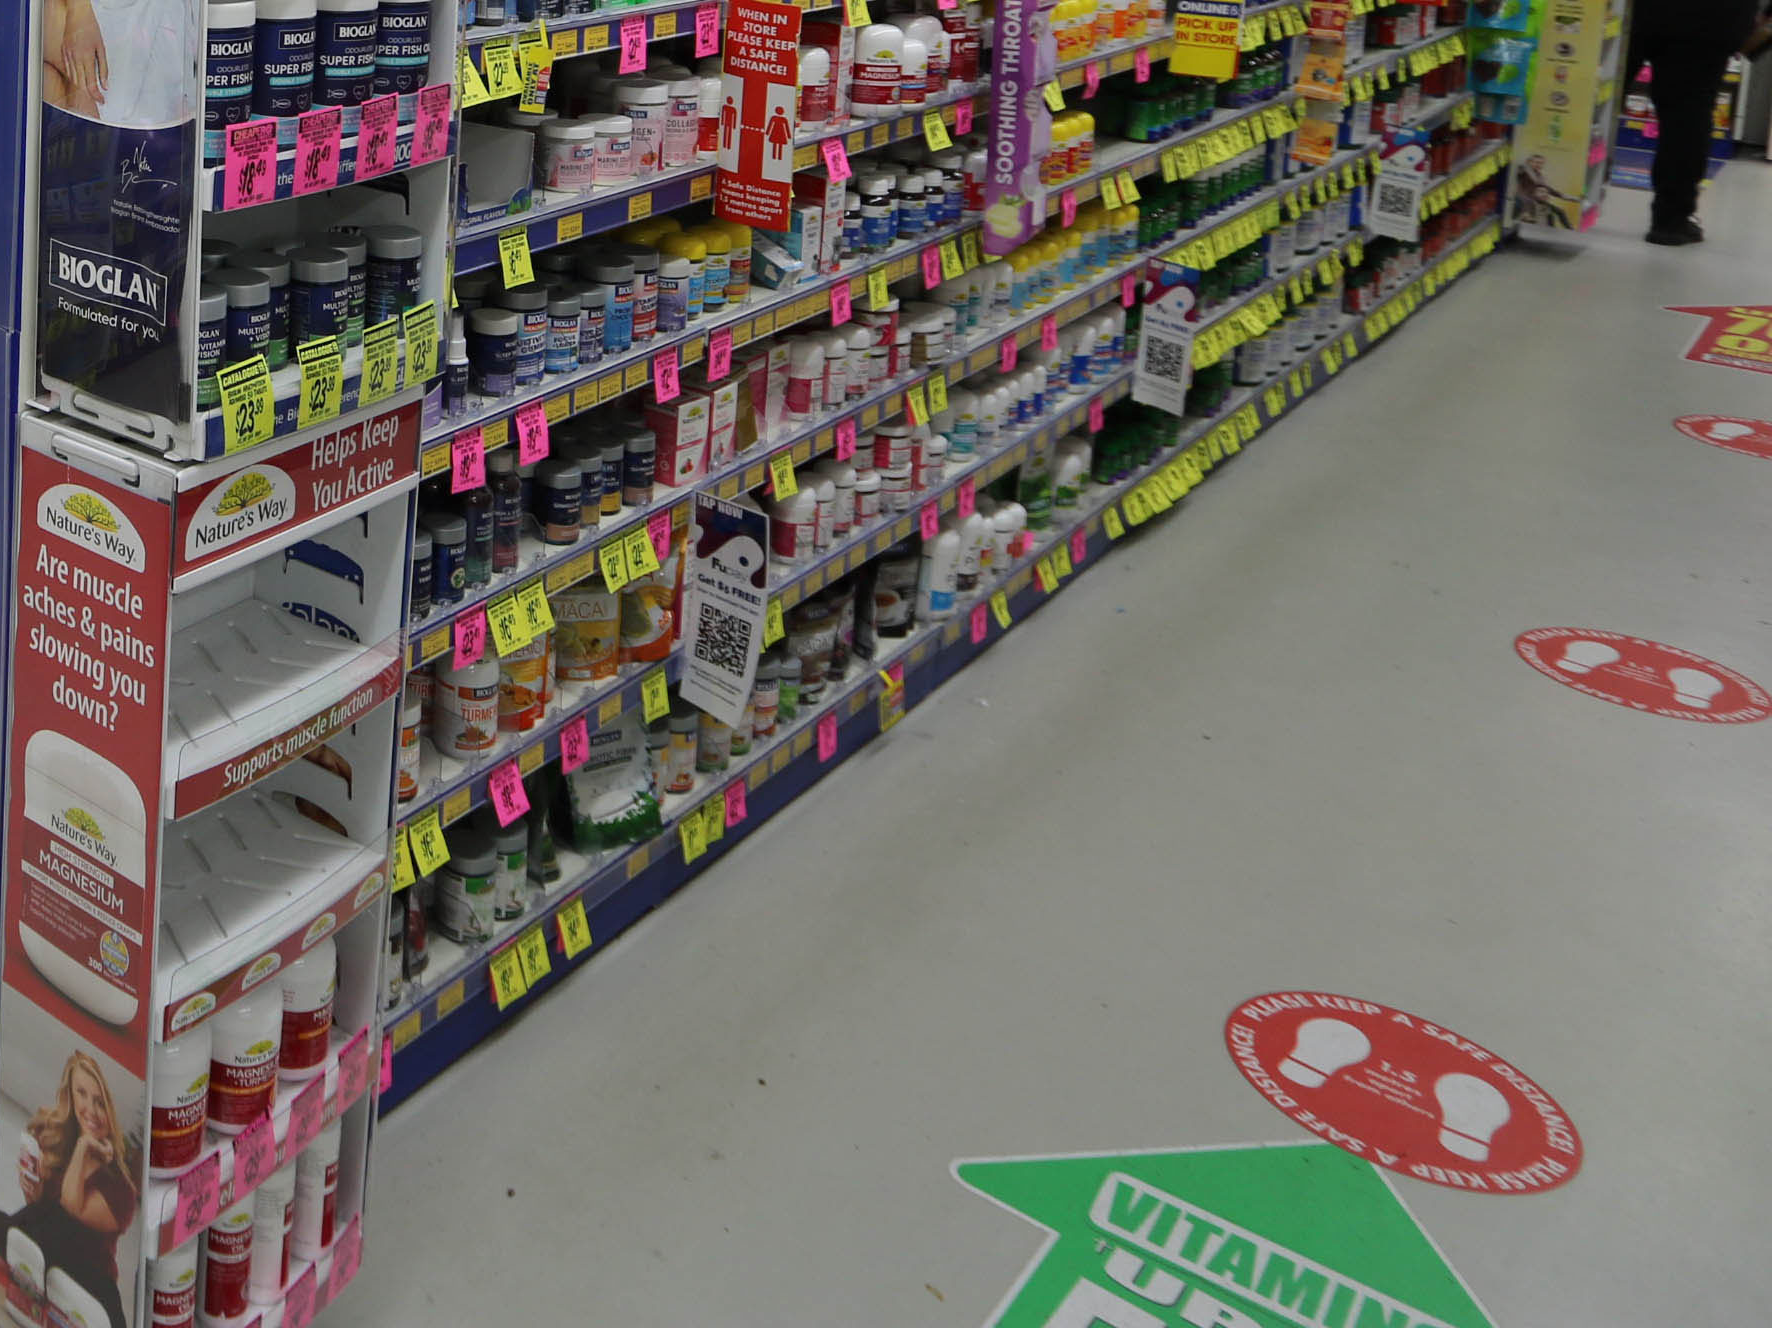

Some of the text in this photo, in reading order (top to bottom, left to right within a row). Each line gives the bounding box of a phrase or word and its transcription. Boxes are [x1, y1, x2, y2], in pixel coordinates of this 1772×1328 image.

[383, 16, 427, 29] BIOGLAN
[737, 7, 788, 25] WHEN IN
[1176, 17, 1237, 32] PICK UP
[1179, 0, 1230, 16] ONLINE
[728, 30, 797, 51] PLEASE KEEP
[743, 20, 777, 37] STORE
[1176, 32, 1236, 45] IN STORE
[319, 54, 355, 66] SUPER
[730, 56, 787, 76] DISTANCE!
[739, 44, 777, 62] A SAFE
[57, 252, 161, 314] BIOGLAN
[57, 296, 123, 330] Formulated
[122, 317, 136, 333] for
[311, 414, 400, 471] Helps Keep
[312, 457, 395, 514] You Active
[195, 497, 289, 549] Nature's Way
[698, 494, 744, 519] TAP NOW
[45, 506, 138, 564] Nature's Way
[35, 544, 144, 621] Are muscle
[731, 586, 762, 607] FREE!
[23, 583, 156, 669] aches & pains
[28, 623, 147, 707] slowing you
[51, 674, 120, 732] down?
[222, 694, 374, 788] Supports muscle function
[38, 849, 125, 915] MAGNESIUM
[1241, 992, 1575, 1156] PLEASE KEEP A SAFE DISTANCE!
